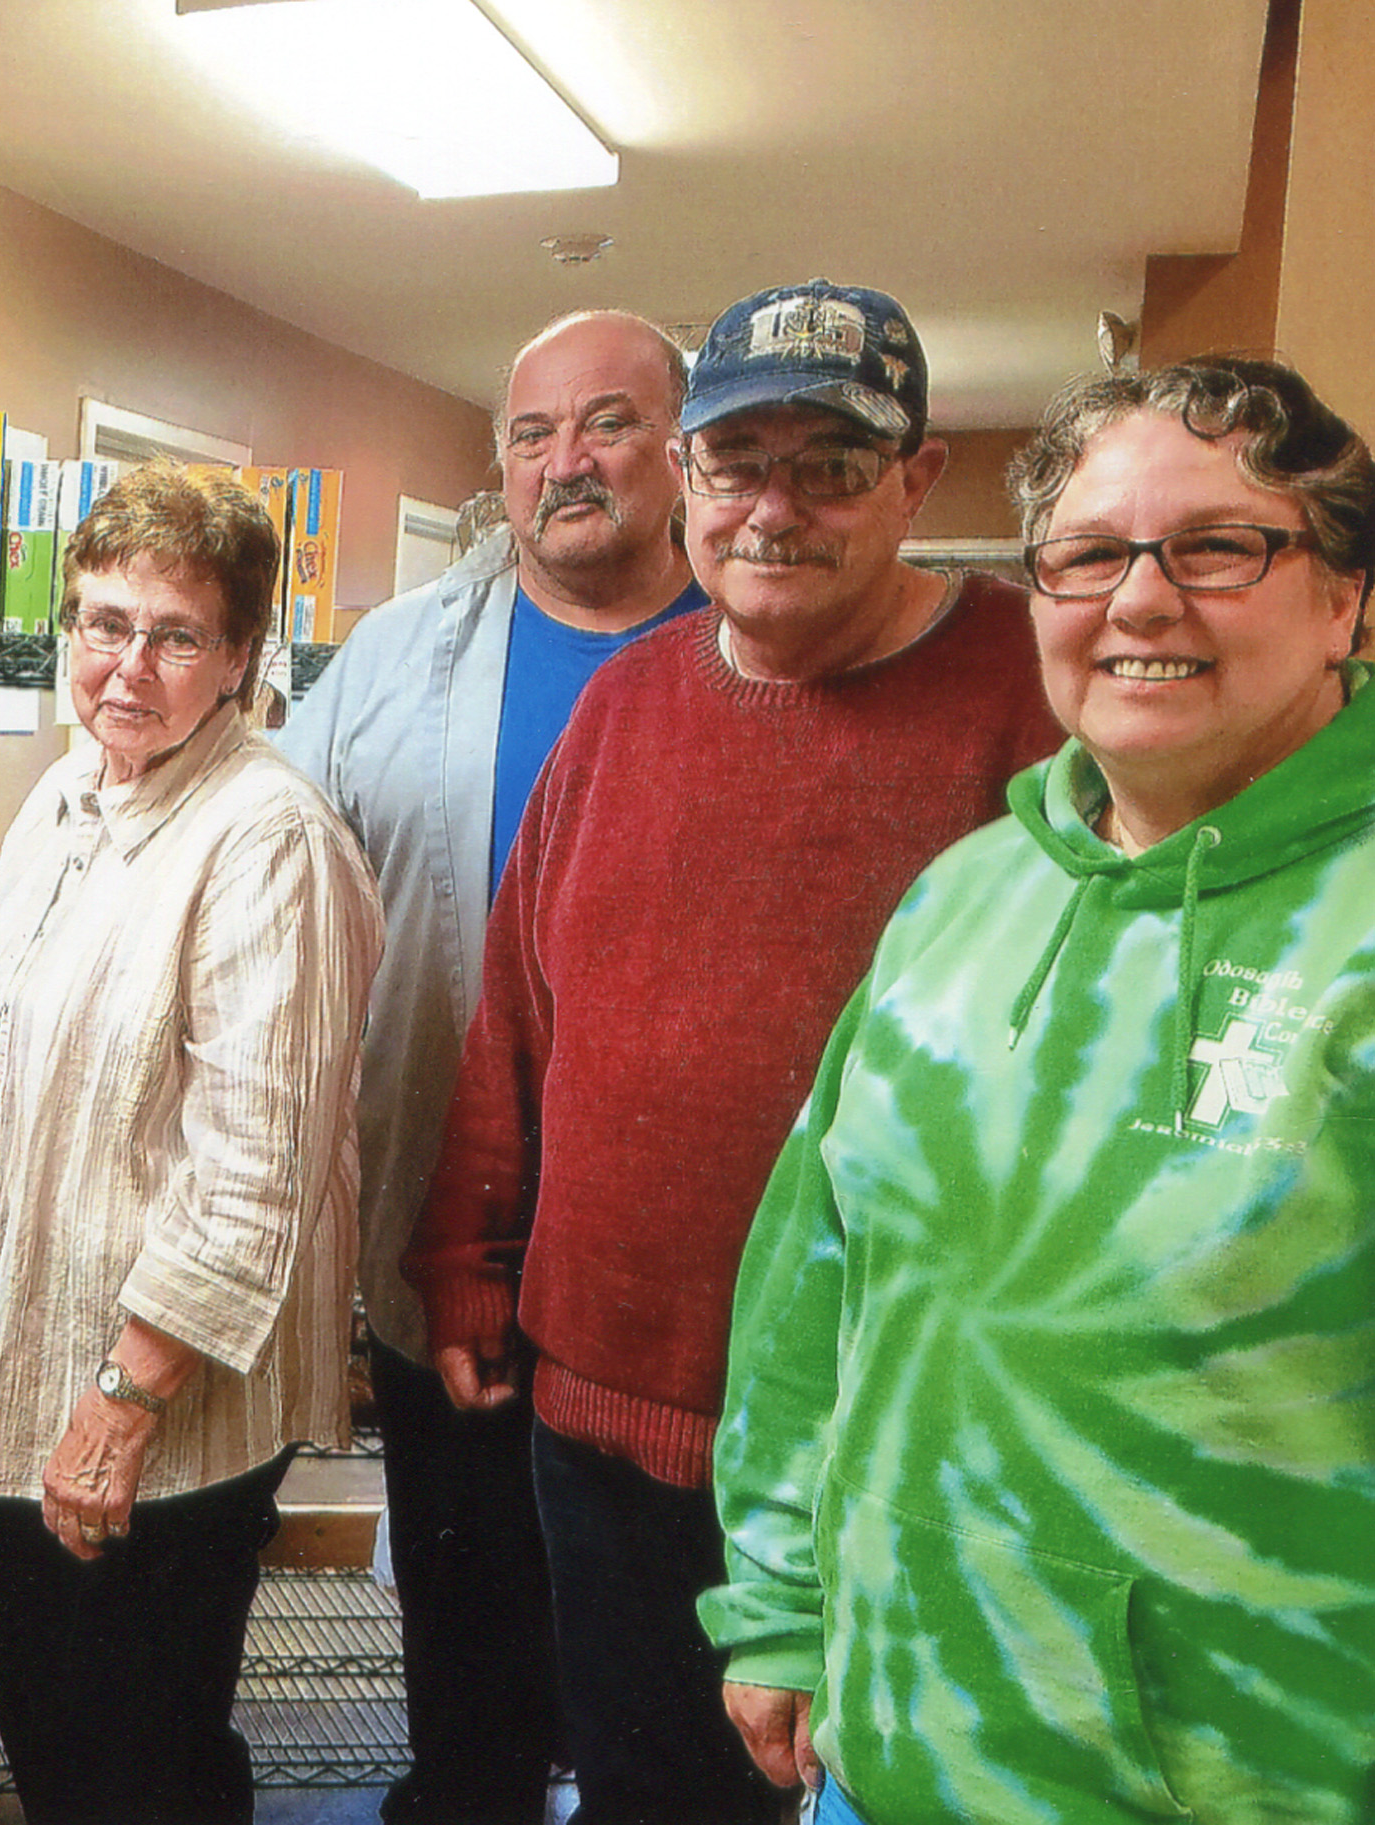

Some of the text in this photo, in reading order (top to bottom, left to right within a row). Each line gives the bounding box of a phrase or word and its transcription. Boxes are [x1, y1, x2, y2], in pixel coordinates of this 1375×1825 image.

[8, 531, 23, 569] Chex
[303, 541, 320, 579] Chex
[1228, 986, 1308, 1020] Bible
